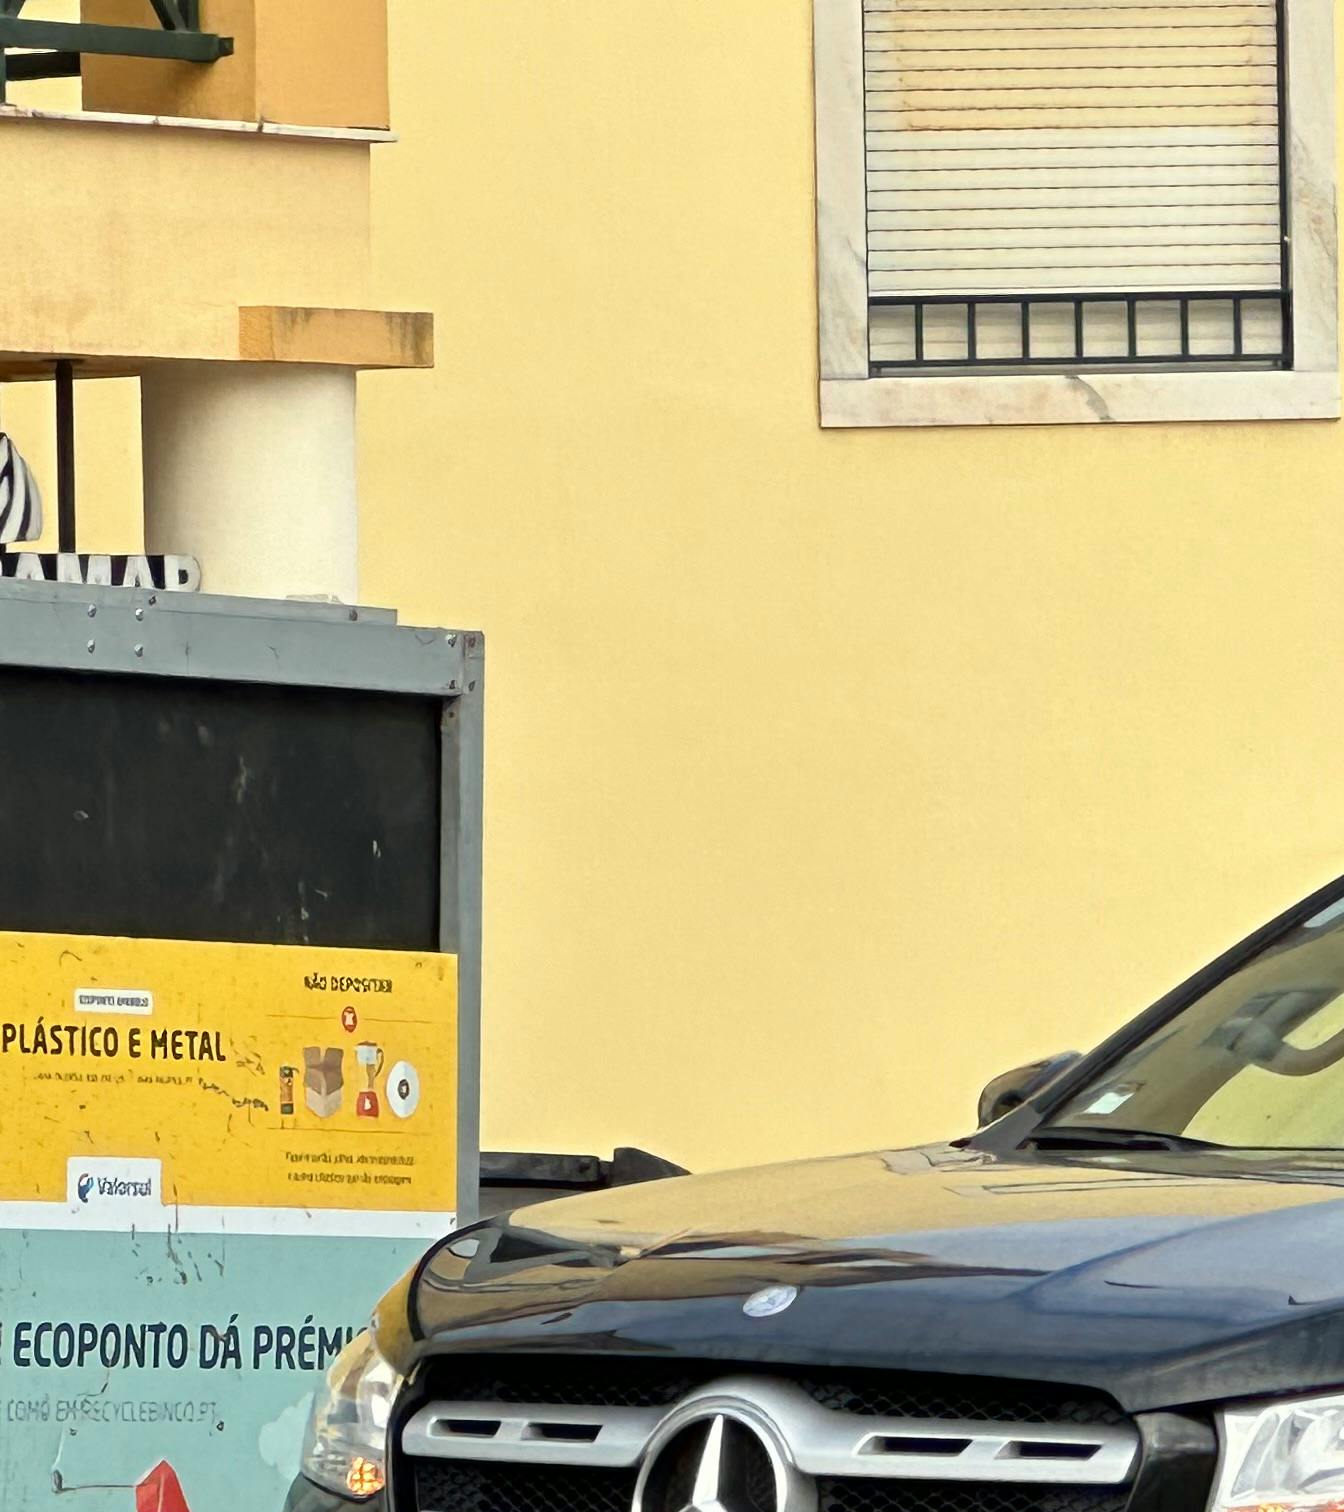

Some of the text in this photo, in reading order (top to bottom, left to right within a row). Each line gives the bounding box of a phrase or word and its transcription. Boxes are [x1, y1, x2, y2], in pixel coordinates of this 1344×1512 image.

[2, 1016, 226, 1062] PLÁSTICO E METAL
[13, 1321, 189, 1369] ECOPONTO
[199, 1313, 242, 1370] DÁ
[252, 1314, 369, 1370] PRÉM
